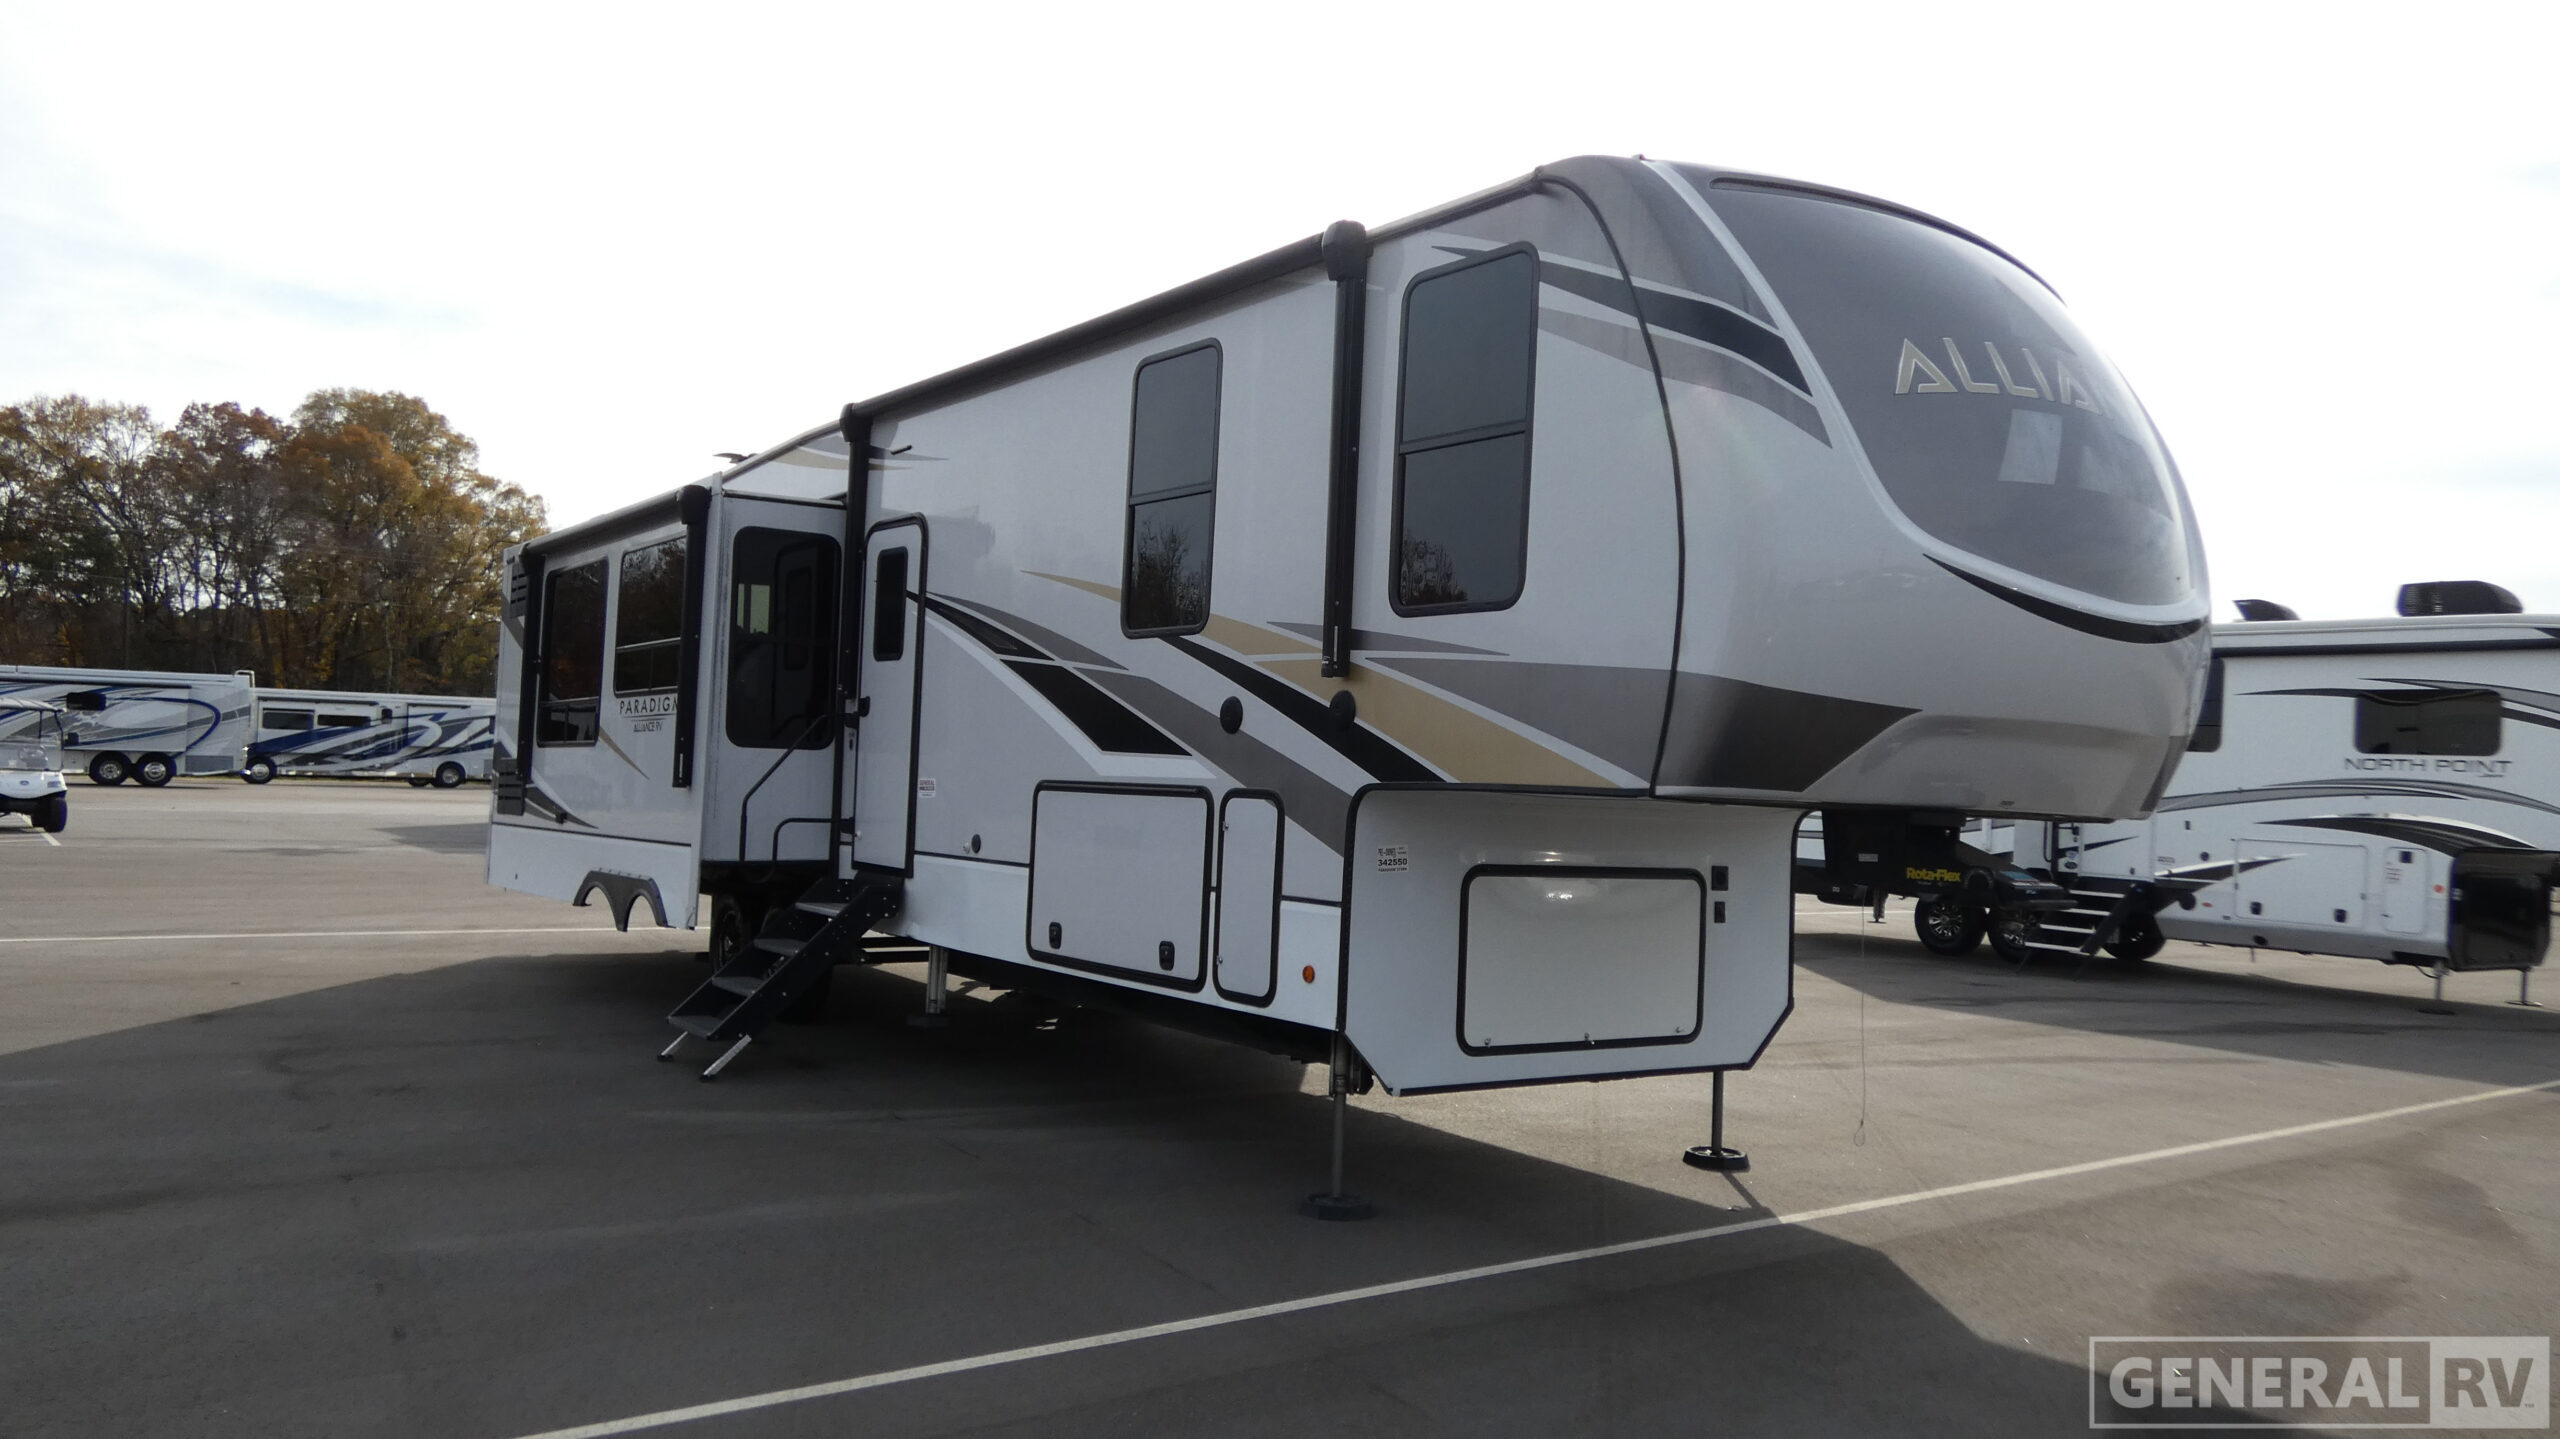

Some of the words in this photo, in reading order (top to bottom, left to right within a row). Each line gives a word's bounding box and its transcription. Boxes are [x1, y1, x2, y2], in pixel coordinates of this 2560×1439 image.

[1895, 337, 2103, 416] ALLIA
[2344, 758, 2427, 772] NORTH
[2435, 759, 2513, 774] POINT
[1378, 858, 1408, 866] 342550
[1906, 867, 1961, 882] Rota-Flex
